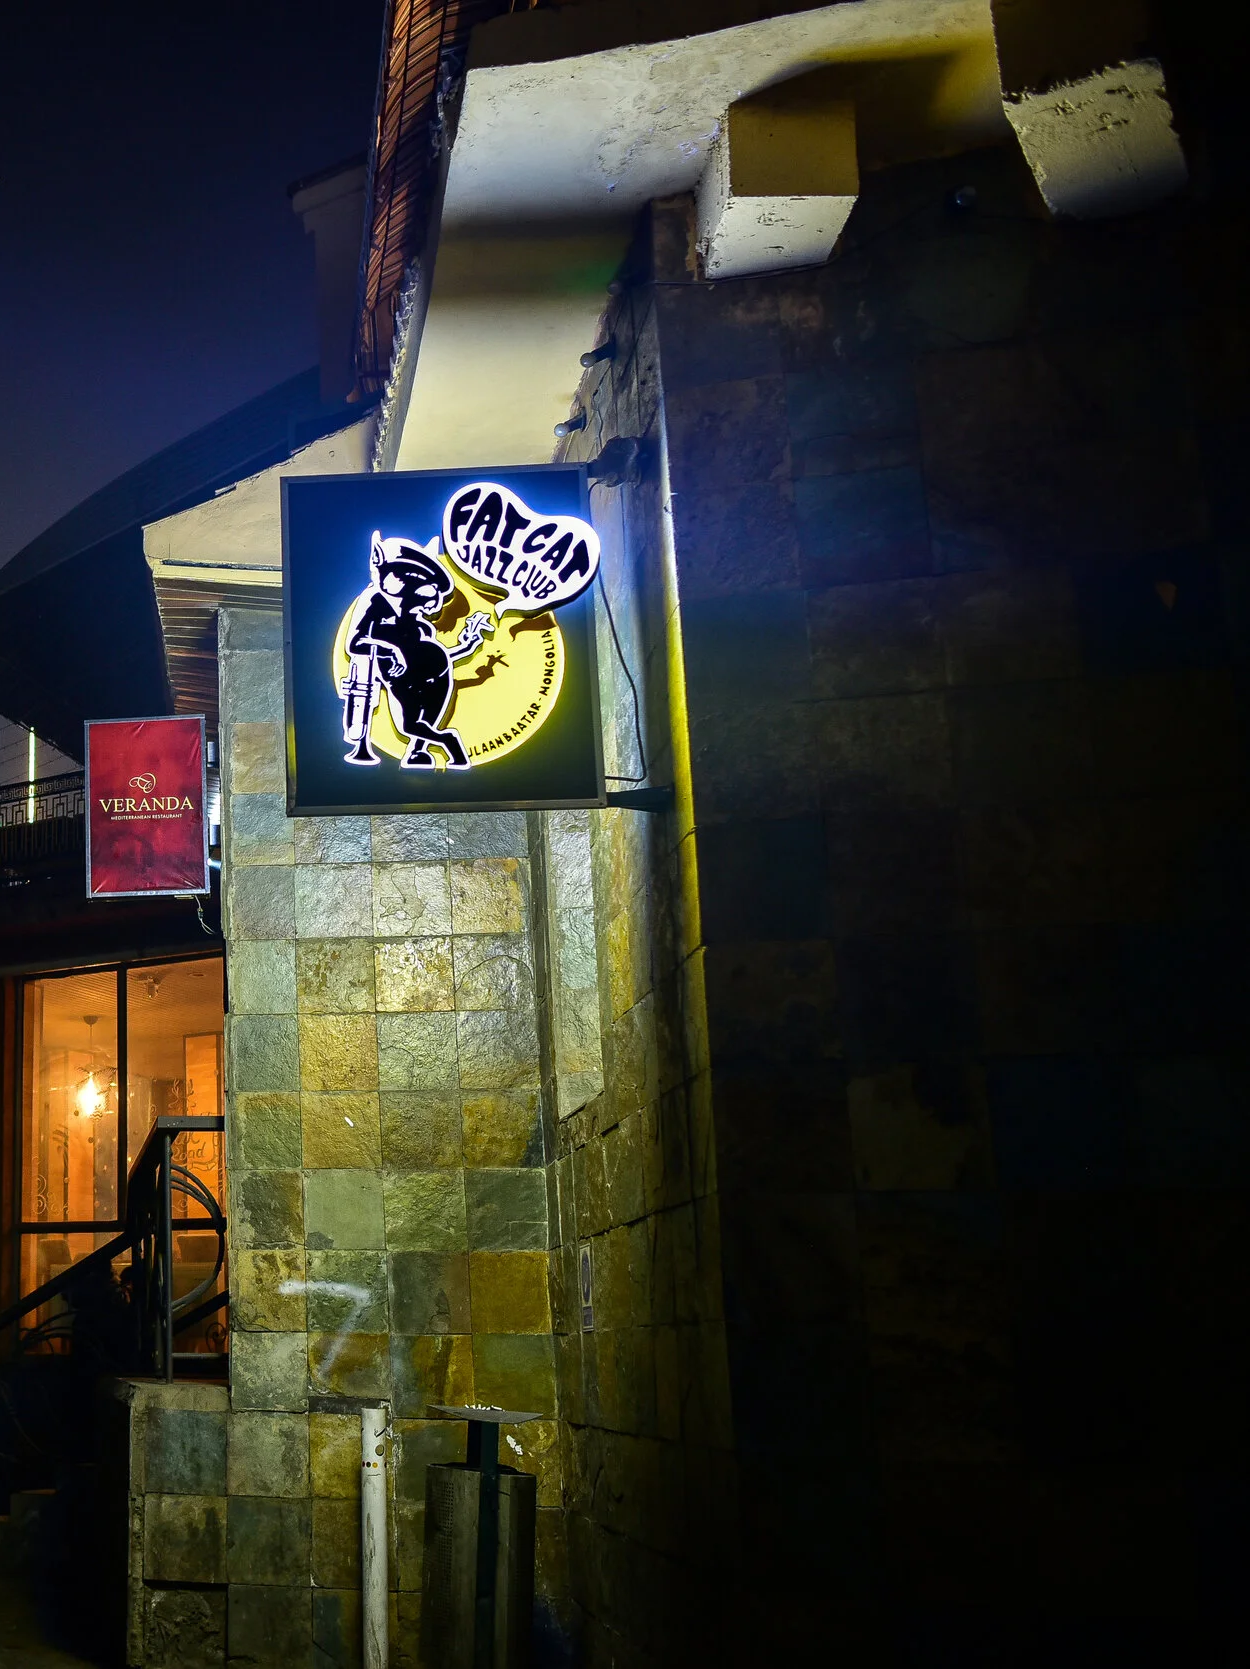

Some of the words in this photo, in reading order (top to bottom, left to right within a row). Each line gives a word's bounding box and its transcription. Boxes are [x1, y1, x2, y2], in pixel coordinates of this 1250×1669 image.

[450, 488, 531, 548] FAT
[522, 523, 590, 583] CAT
[456, 544, 514, 584] JAZZ
[512, 560, 557, 599] CLUB
[539, 631, 556, 696] MONGOLIA
[99, 796, 194, 812] VERANDA
